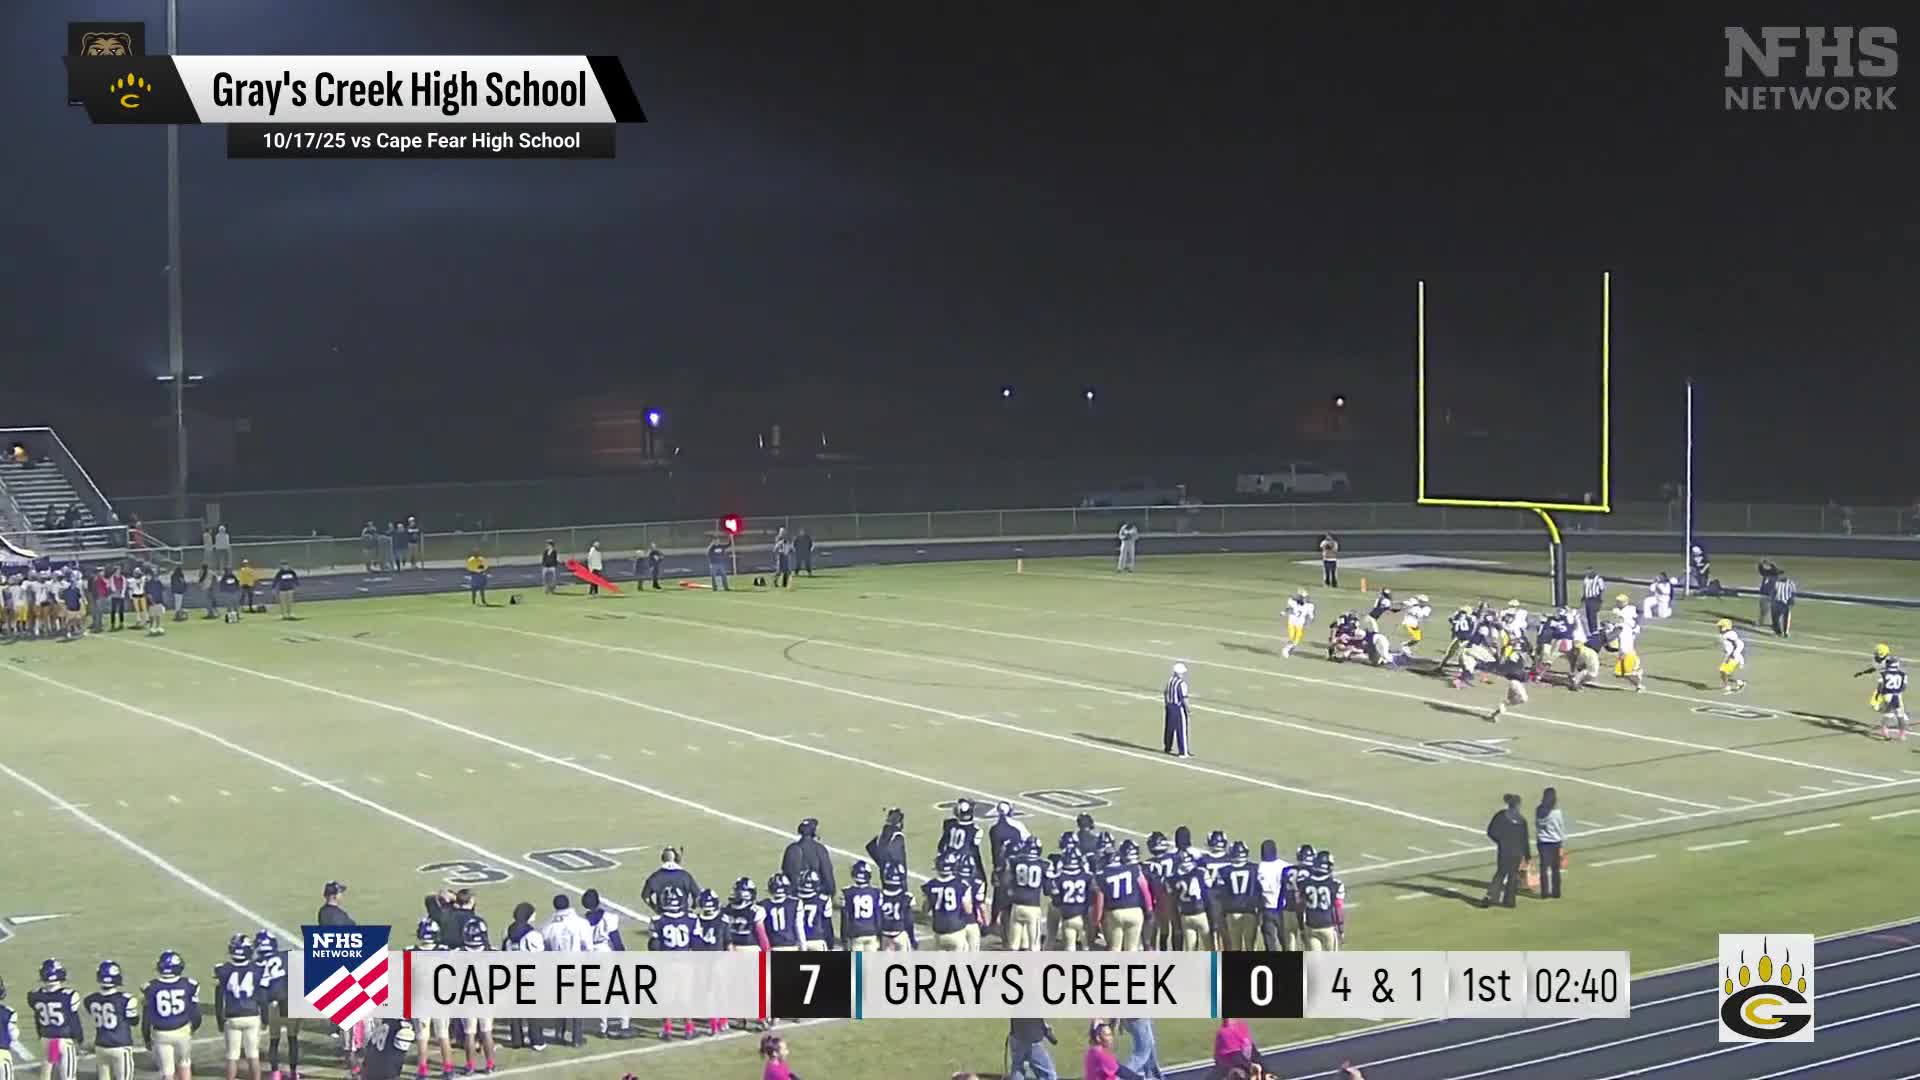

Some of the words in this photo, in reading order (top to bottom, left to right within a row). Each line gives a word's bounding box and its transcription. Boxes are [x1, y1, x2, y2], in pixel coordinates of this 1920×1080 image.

[1885, 673, 1902, 689] 20
[950, 827, 966, 850] 10
[416, 847, 622, 885] 30
[1015, 863, 1042, 888] 80
[1062, 879, 1087, 904] 23
[1106, 871, 1133, 899] 77
[1176, 877, 1201, 902] 24
[1230, 870, 1250, 895] 17
[853, 894, 873, 919] 19
[931, 887, 957, 911] 79
[1305, 886, 1331, 910] 33
[770, 907, 785, 932] 11
[663, 919, 690, 948] 90
[227, 972, 254, 999] 44
[35, 1002, 65, 1026] 35
[90, 1002, 117, 1029] 66
[156, 990, 185, 1017] 65
